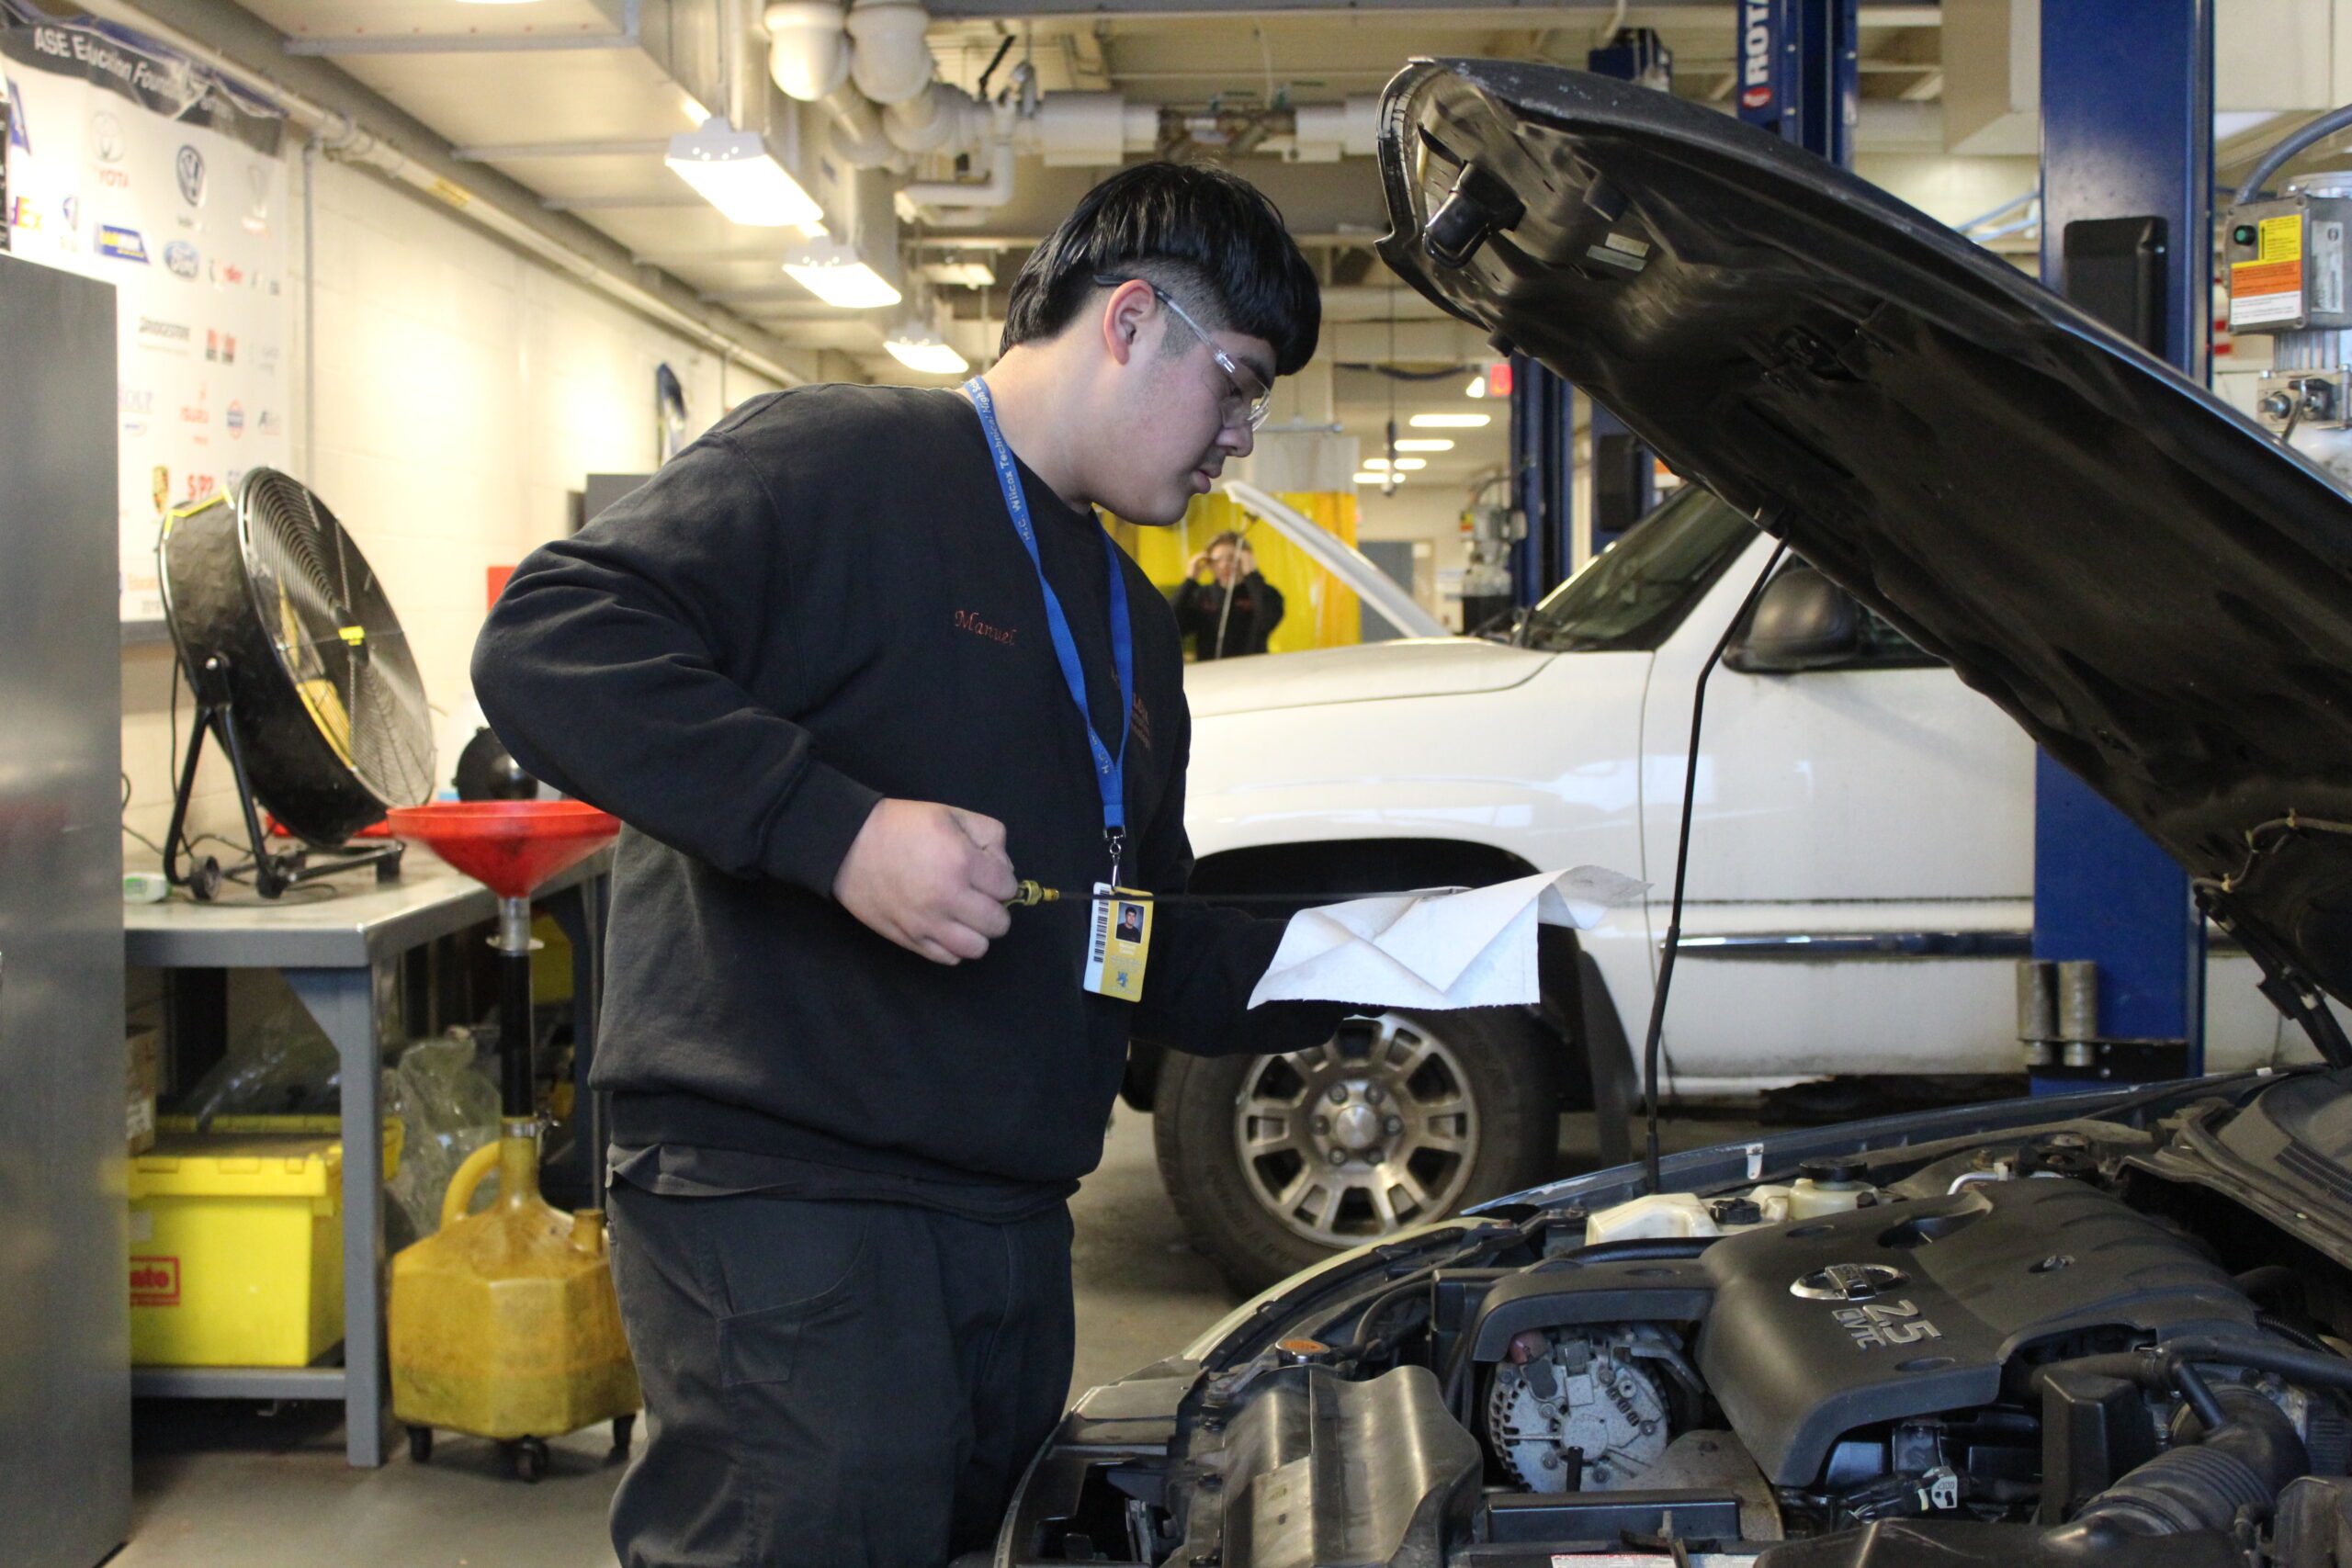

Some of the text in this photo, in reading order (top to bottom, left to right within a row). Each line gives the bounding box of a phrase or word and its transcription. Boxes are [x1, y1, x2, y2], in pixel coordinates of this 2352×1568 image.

[34, 26, 72, 59] ASE
[1745, 0, 1770, 86] ROT
[977, 392, 990, 414] High
[984, 415, 1011, 469] Technical
[1005, 470, 1022, 513] Wilcox
[955, 610, 1016, 646] Manuel
[1862, 1300, 1942, 1344] 2.5
